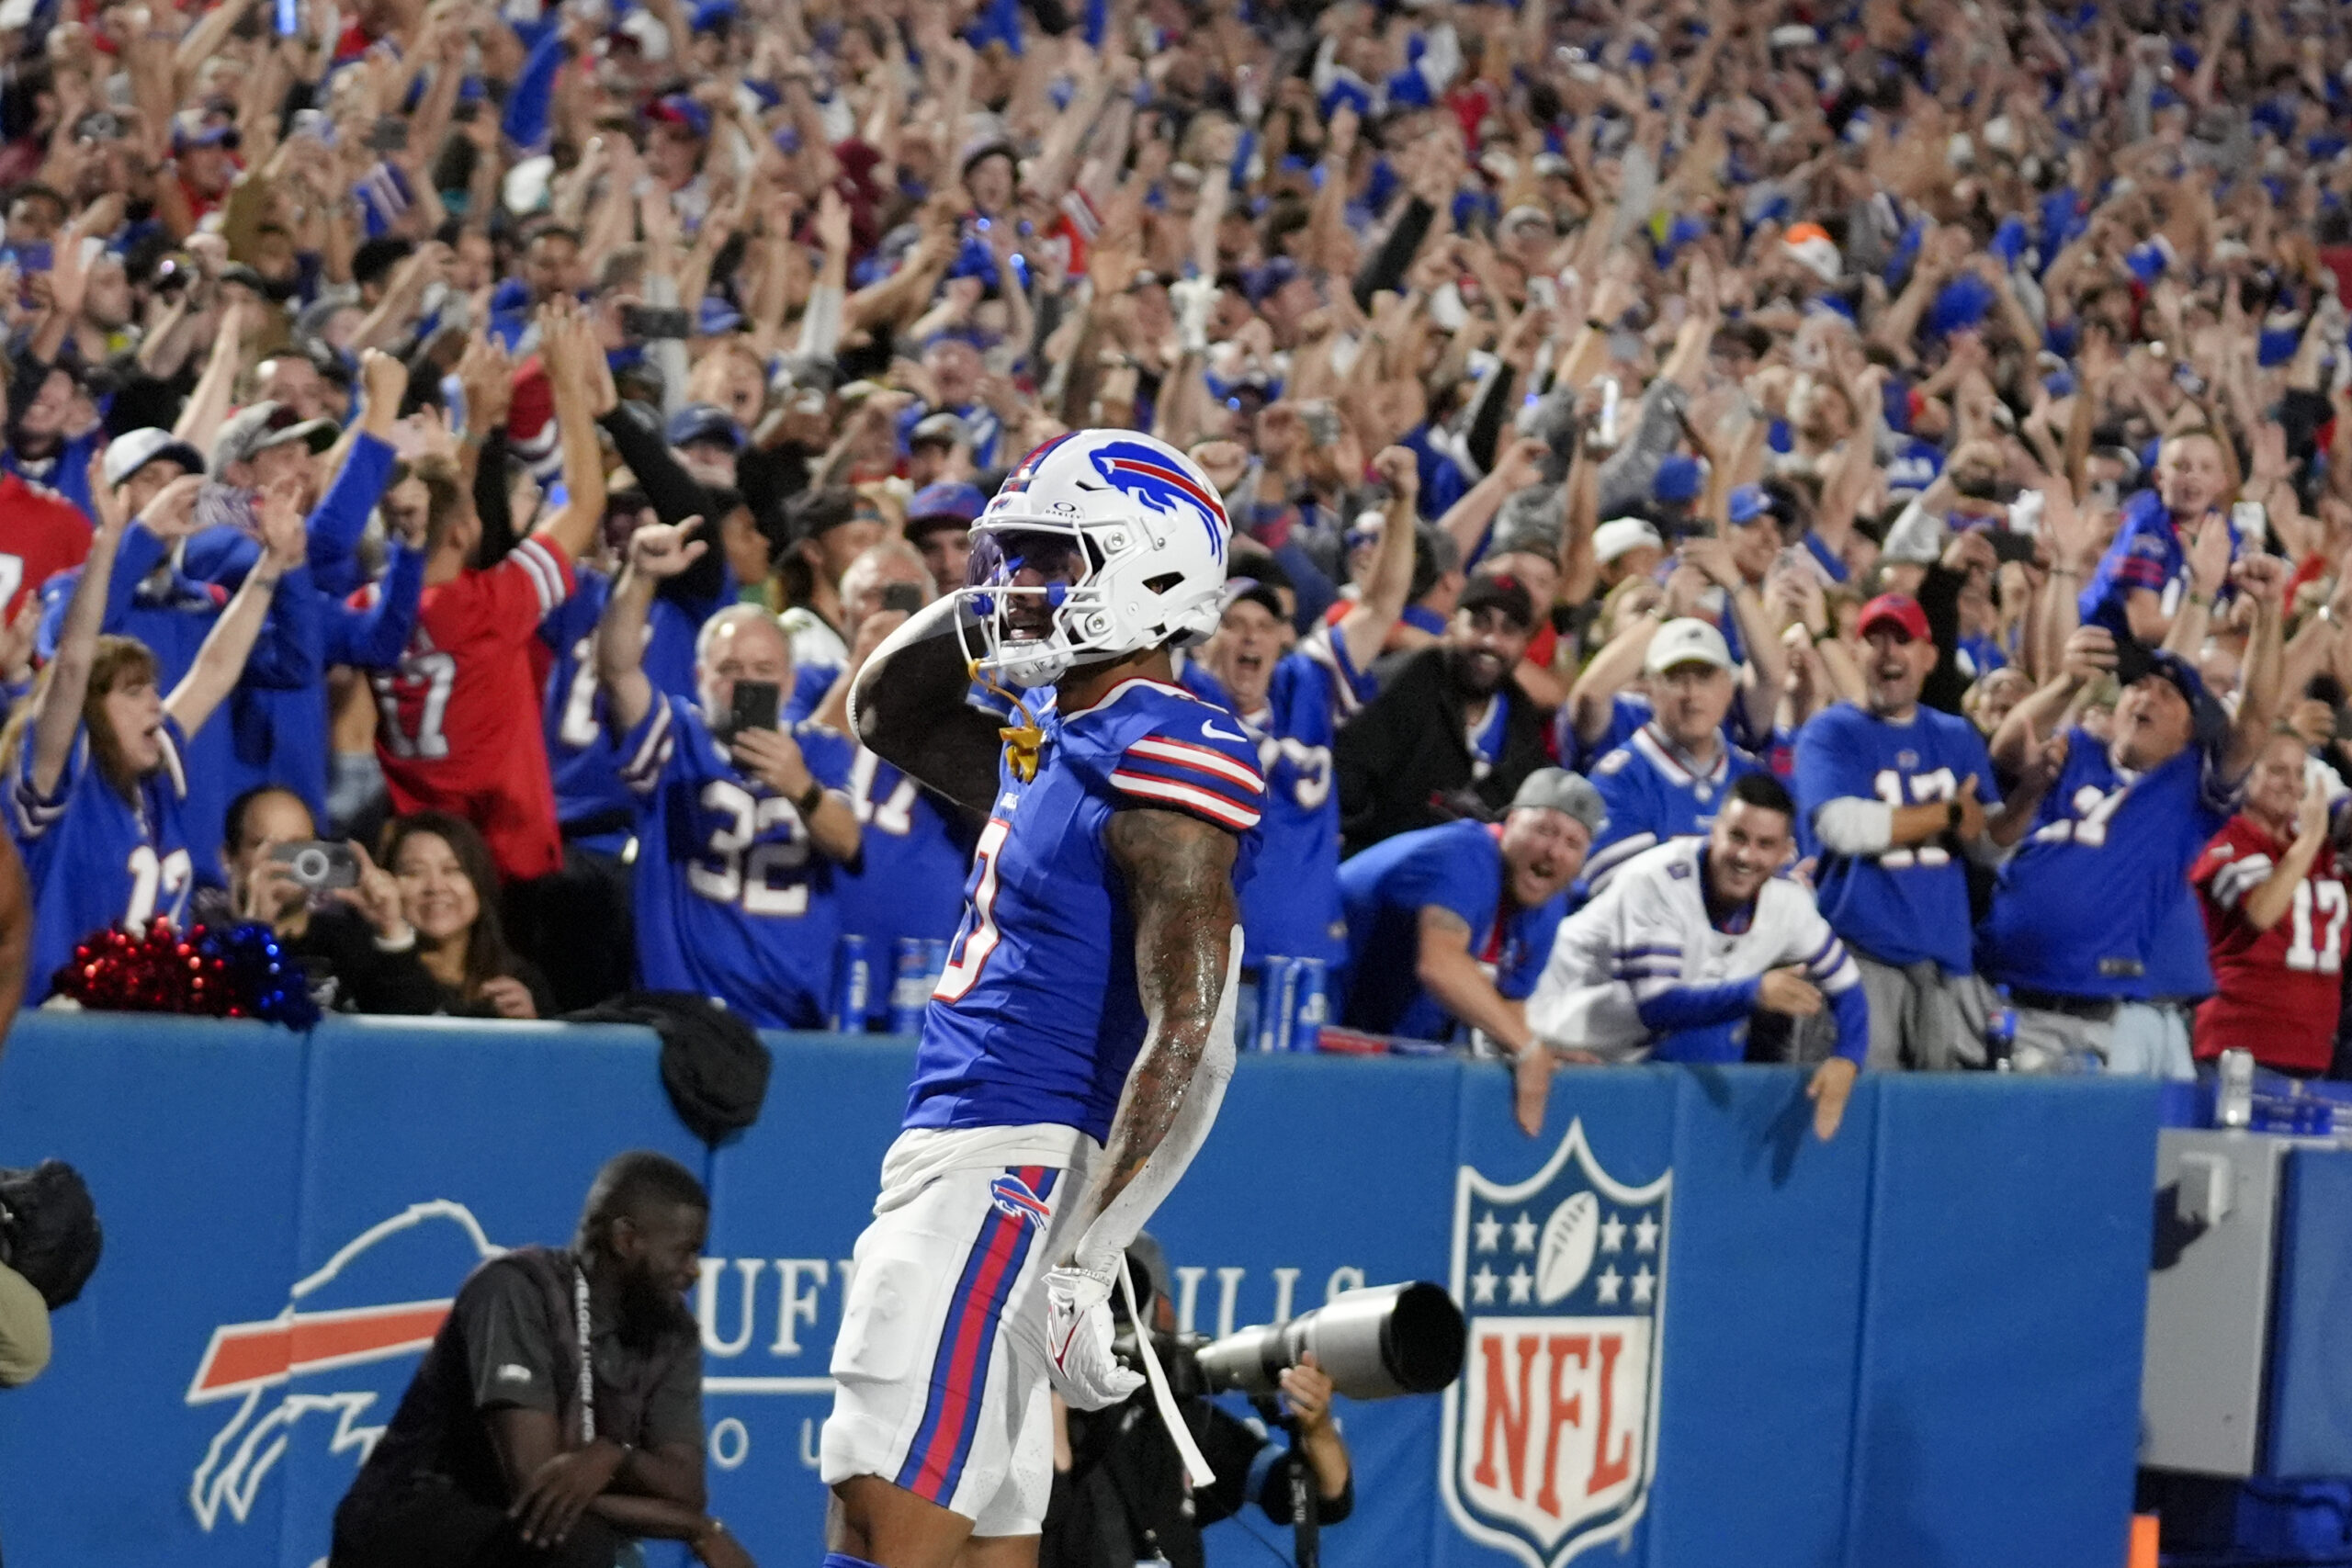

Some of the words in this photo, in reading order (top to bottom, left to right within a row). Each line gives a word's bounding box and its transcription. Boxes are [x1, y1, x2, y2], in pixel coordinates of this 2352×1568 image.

[688, 780, 809, 916] 32
[2286, 877, 2349, 974] 17
[1473, 1334, 1633, 1519] NFL
